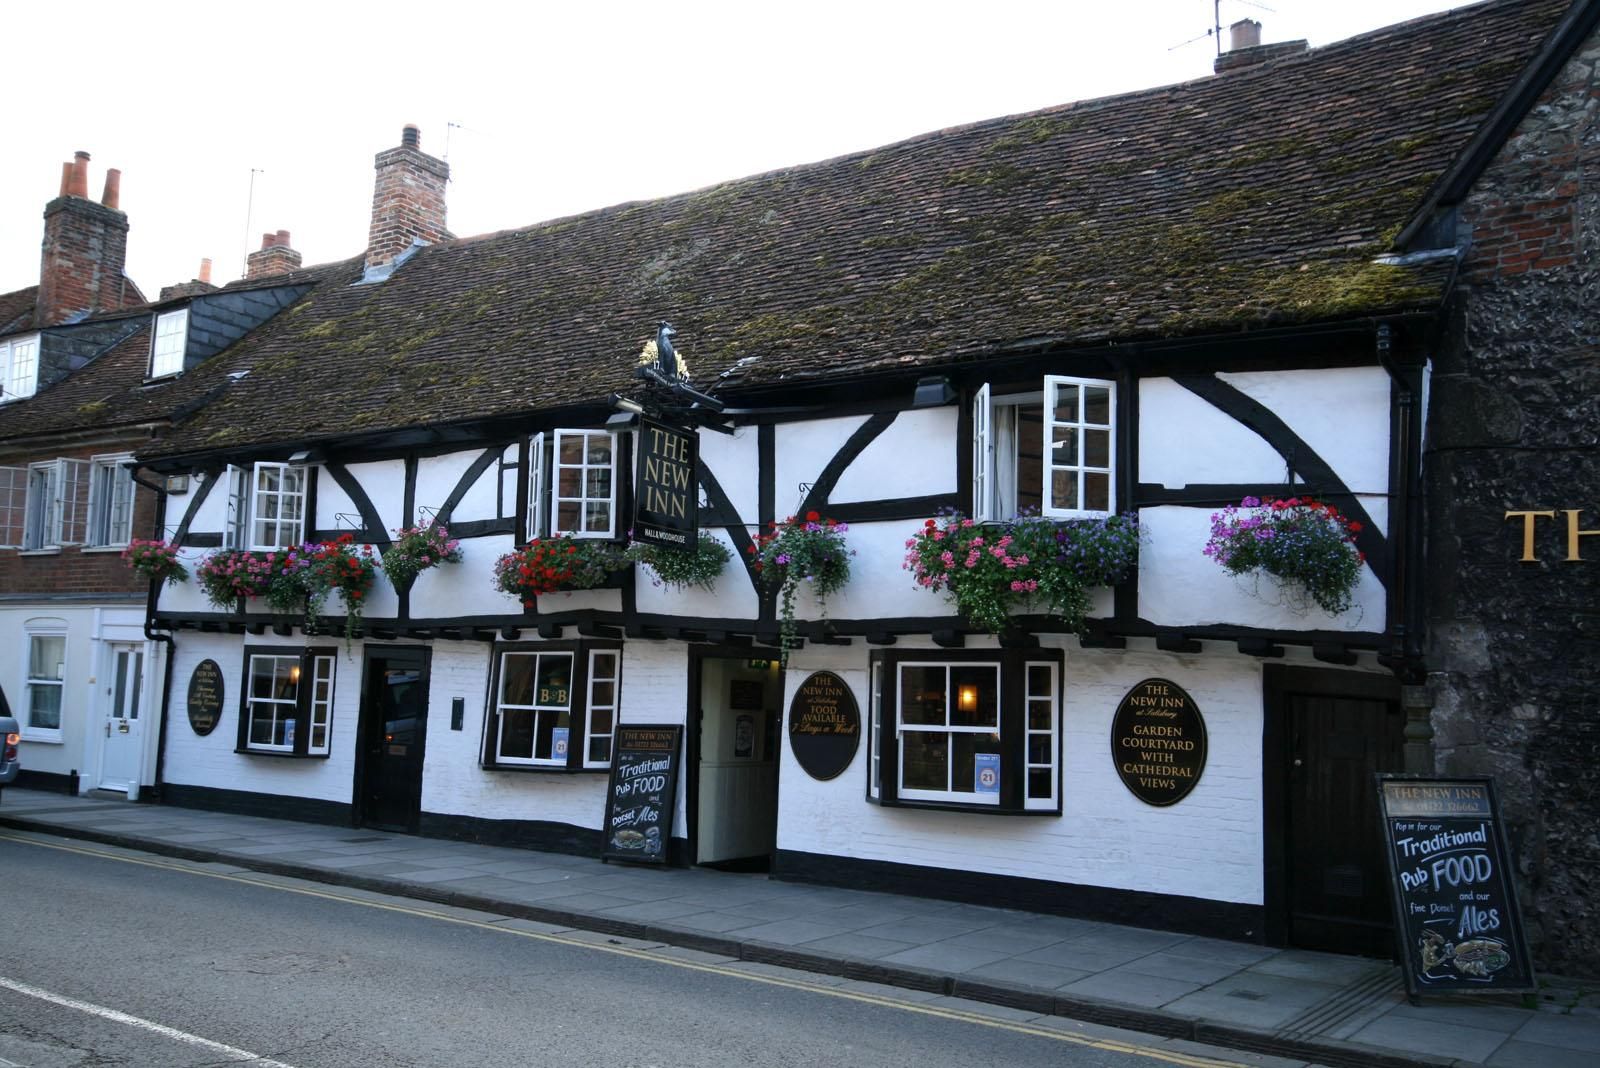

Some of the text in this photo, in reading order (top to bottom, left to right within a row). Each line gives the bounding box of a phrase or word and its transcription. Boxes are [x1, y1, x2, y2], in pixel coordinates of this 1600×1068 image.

[650, 428, 689, 463] THE
[644, 456, 691, 491] NEW
[645, 486, 687, 519] INN
[1504, 509, 1600, 562] TH
[814, 677, 832, 686] THE
[803, 687, 843, 696] NEW INN
[1145, 685, 1169, 695] THE
[1130, 696, 1184, 708] NEW INN
[811, 705, 837, 714] FOOD
[802, 714, 846, 723] AVAILABLE
[1133, 725, 1182, 737] GARDEN
[1122, 737, 1194, 751] COURTYARD
[1141, 751, 1174, 763] WITH
[620, 755, 671, 778] Traditional
[1123, 763, 1192, 777] CATHEDRAL
[982, 773, 993, 782] 21
[1140, 777, 1176, 790] VIEWS
[615, 776, 665, 797] Pub FOOD
[1393, 787, 1481, 799] THE NEW INN
[612, 806, 659, 826] Dorset Ales
[1395, 822, 1407, 833] Pop
[1417, 821, 1428, 831] for
[1397, 823, 1487, 857] Traditional
[1401, 854, 1492, 892] Pub FOOD
[1459, 890, 1491, 901] and our
[1457, 906, 1501, 939] Ales
